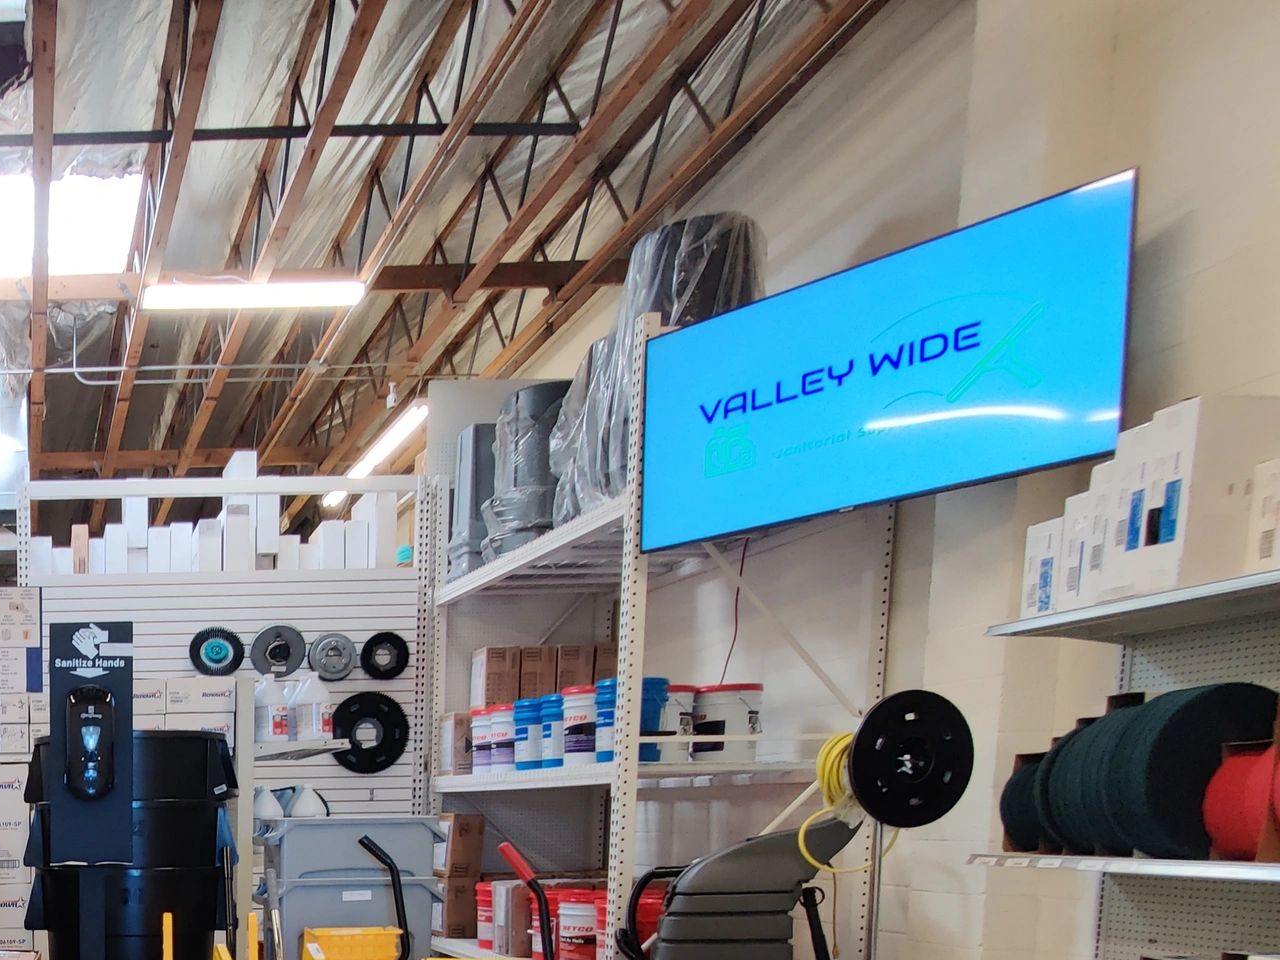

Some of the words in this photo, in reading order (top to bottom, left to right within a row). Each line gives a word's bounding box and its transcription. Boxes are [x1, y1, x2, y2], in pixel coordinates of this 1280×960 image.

[699, 358, 854, 424] VALLEY
[868, 320, 983, 377] WIDE
[55, 658, 93, 668] Sanitize
[95, 658, 126, 668] Hands
